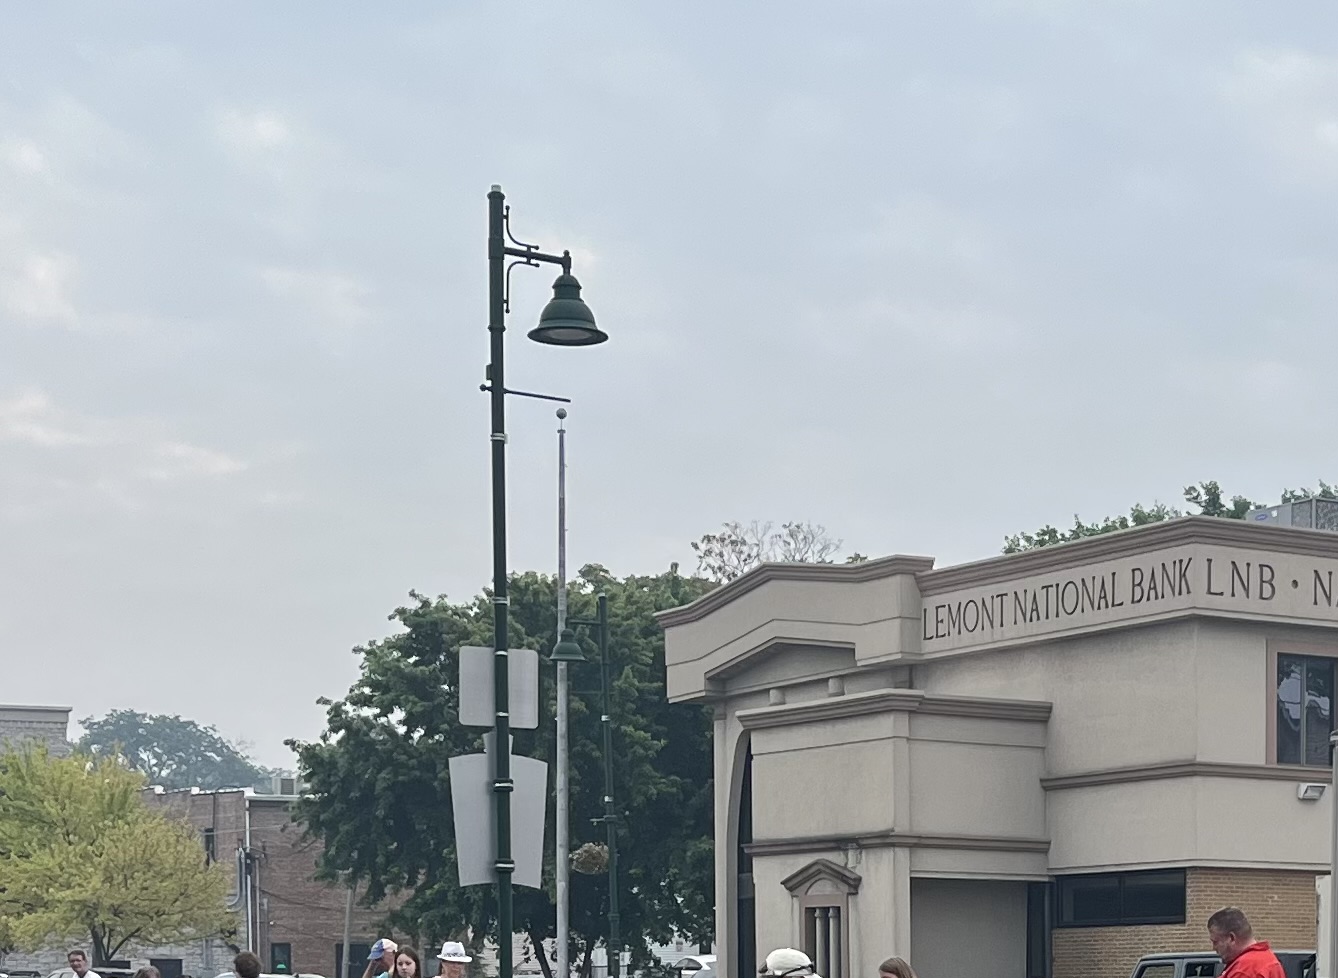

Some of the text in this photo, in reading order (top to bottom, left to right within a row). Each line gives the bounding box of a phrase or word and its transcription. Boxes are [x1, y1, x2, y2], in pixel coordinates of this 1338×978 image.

[923, 556, 1193, 641] LEMONT NATIONAL BANK
[1205, 557, 1277, 601] LNB
